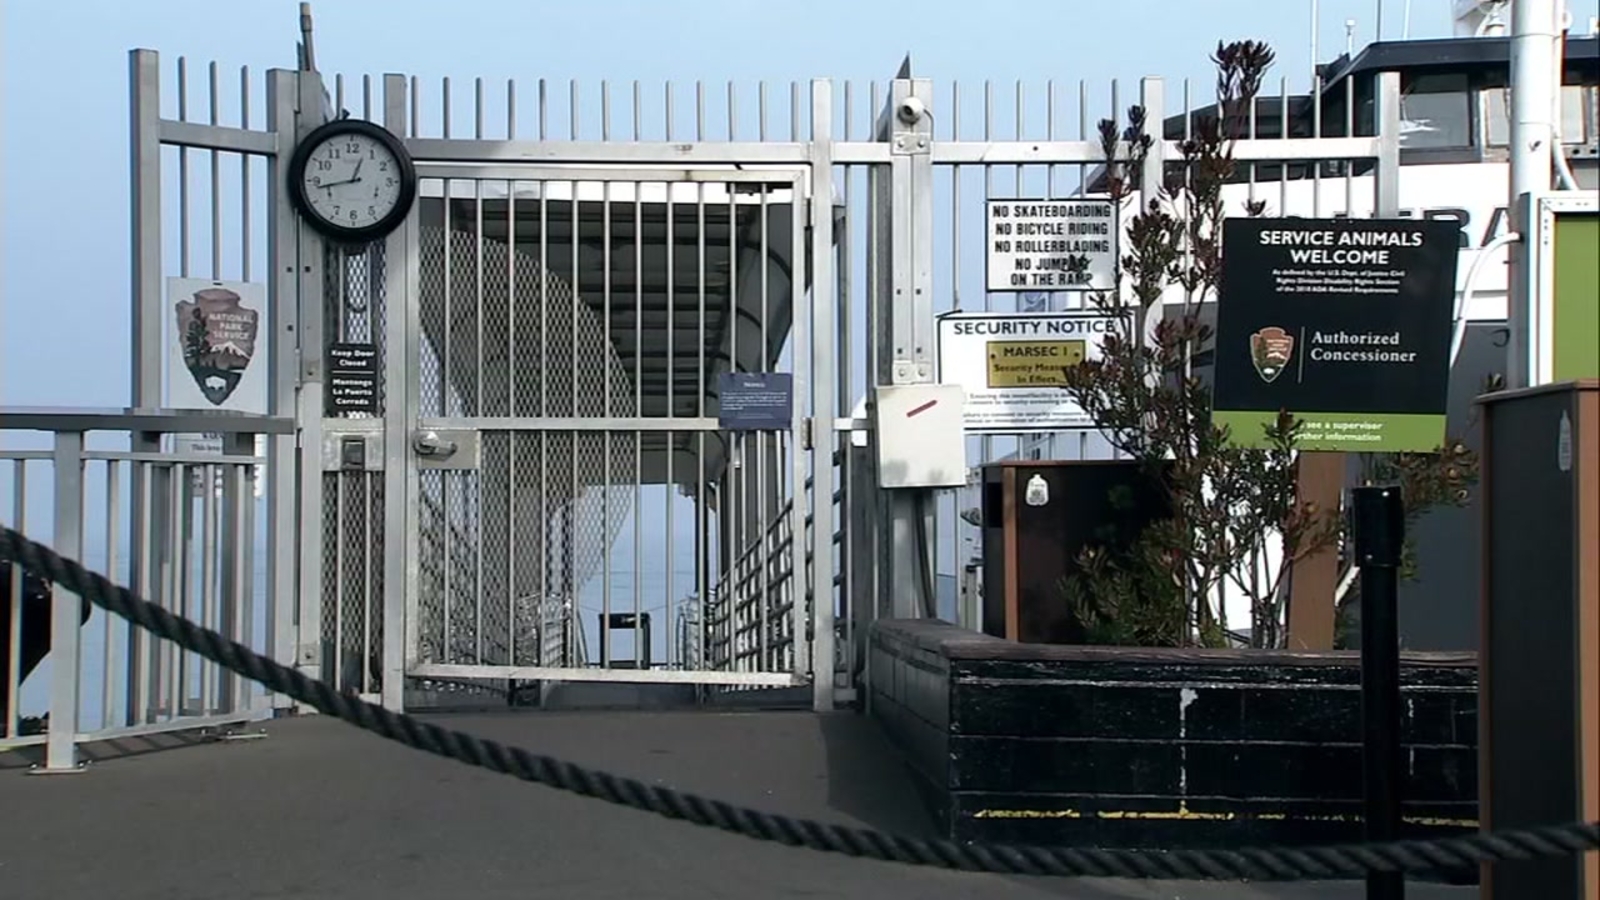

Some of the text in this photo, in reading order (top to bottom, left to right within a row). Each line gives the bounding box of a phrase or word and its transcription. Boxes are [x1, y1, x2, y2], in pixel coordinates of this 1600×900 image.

[328, 149, 341, 159] 11
[345, 143, 359, 154] 12
[369, 149, 375, 160] 1
[318, 161, 332, 171] 10
[379, 161, 387, 172] 2
[386, 177, 394, 188] 3
[333, 205, 340, 215] 7
[349, 210, 358, 220] 6
[367, 205, 376, 216] 5
[992, 205, 1111, 217] NO SKATEBOARDING
[995, 223, 1108, 235] NO BICYCLE RIDING
[1260, 230, 1423, 246] SERVICE ANIMALS
[994, 240, 1109, 252] NO ROLLERBLADING
[1290, 249, 1389, 264] WELCOME
[1014, 258, 1087, 271] NO JUMP
[1010, 273, 1093, 285] ON THE RAMP
[208, 313, 253, 322] NATIONAL
[220, 322, 243, 330] PARK
[953, 320, 1115, 335] SECURITY NOTICE
[213, 330, 250, 339] SERVICE
[1311, 331, 1400, 345] Authorized
[331, 350, 352, 358] Keep
[1003, 346, 1058, 357] MARSEC
[1310, 347, 1417, 362] Concessioner
[993, 364, 1032, 373] Security
[1333, 421, 1383, 432] supervisor
[1293, 431, 1381, 441] rther information
